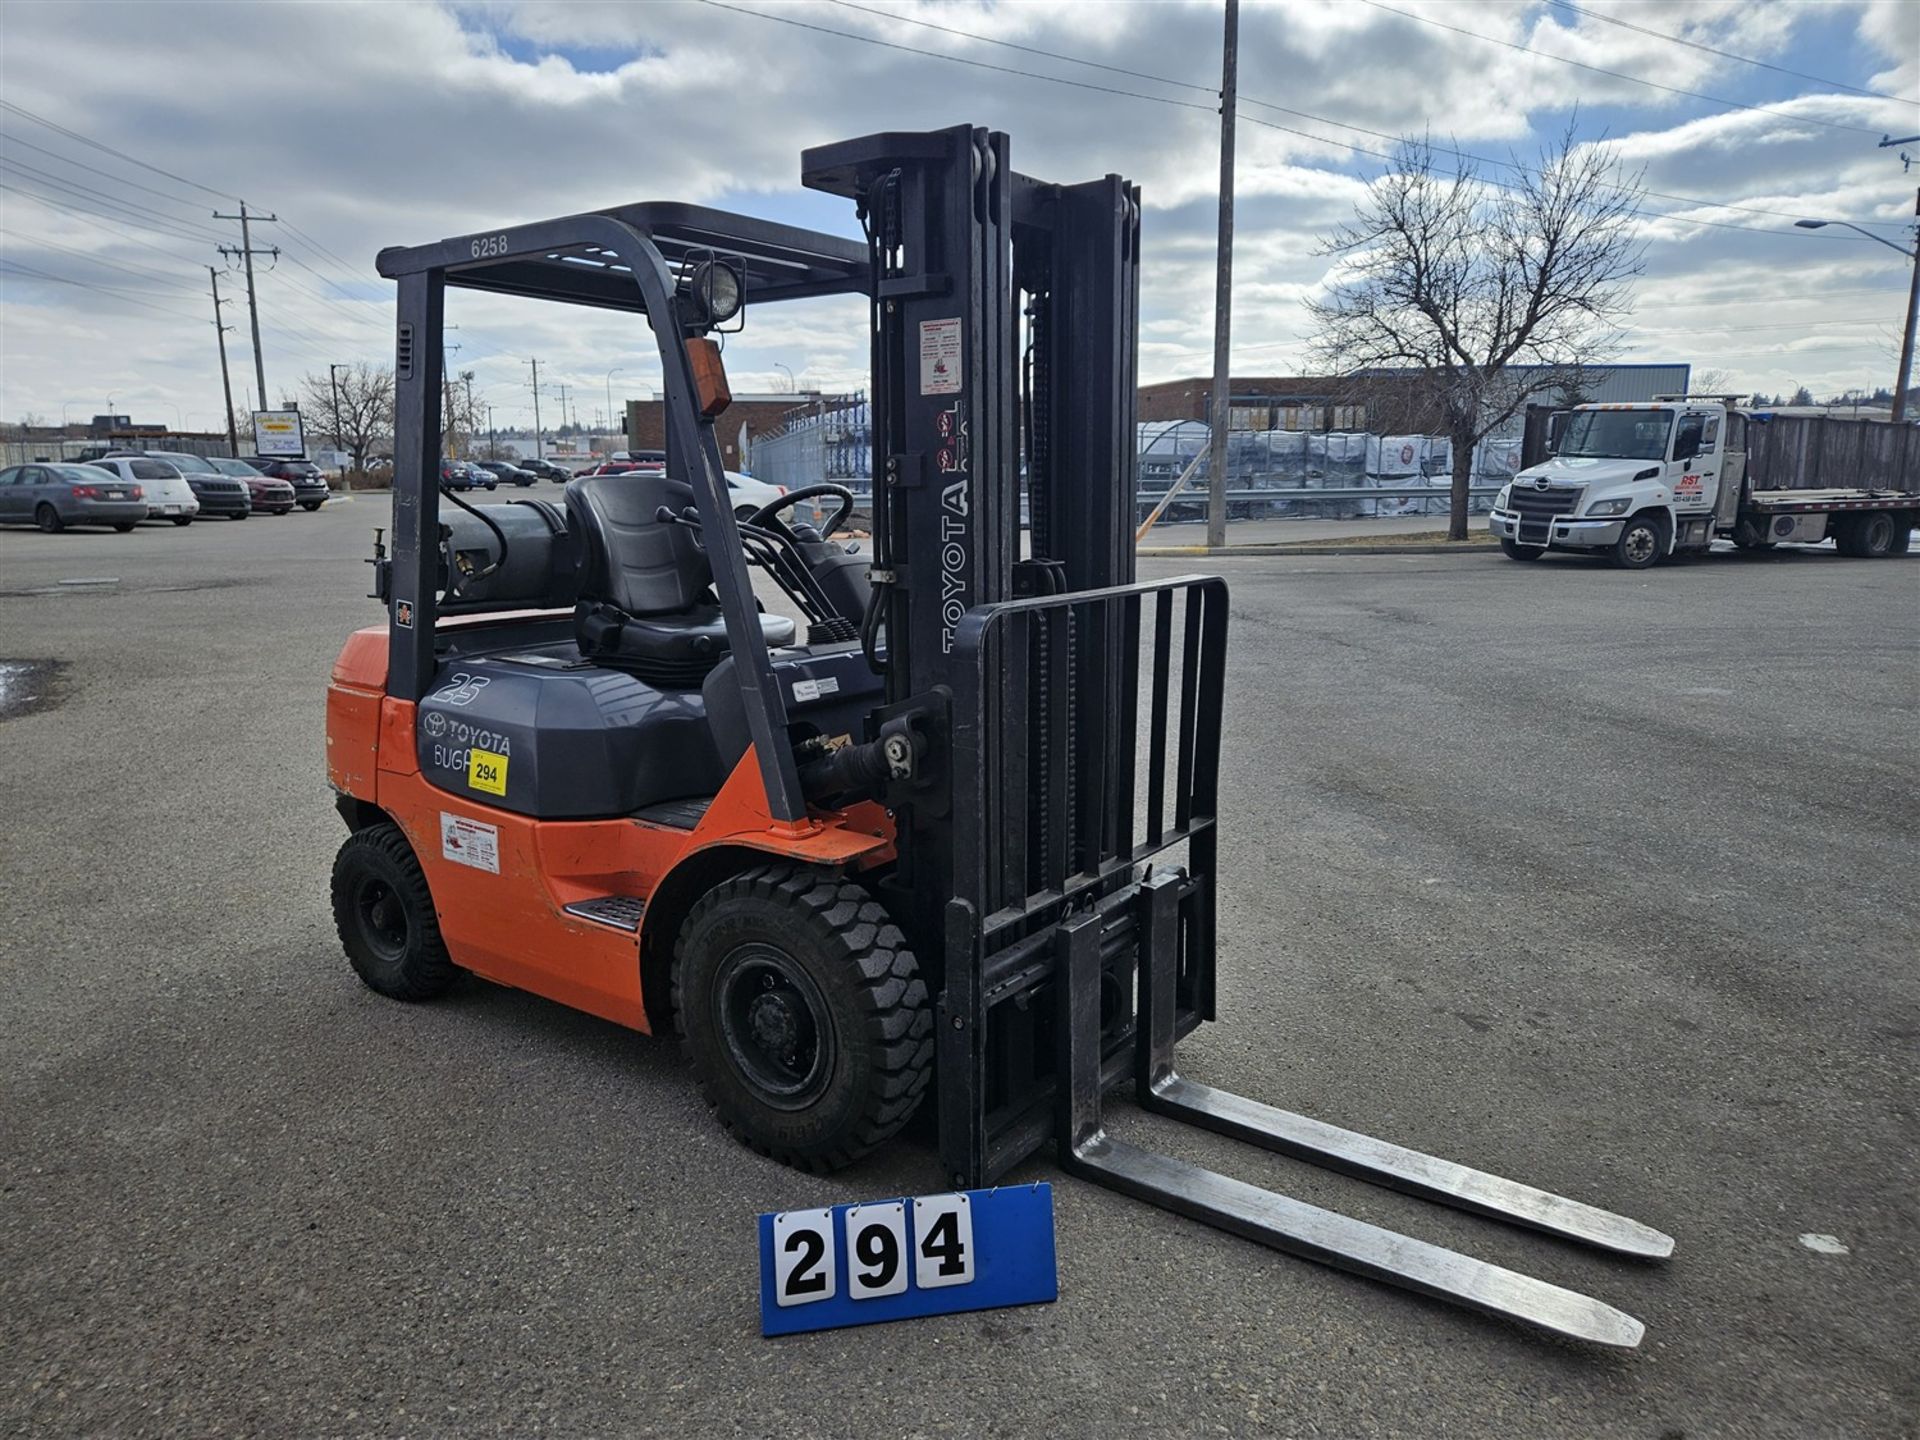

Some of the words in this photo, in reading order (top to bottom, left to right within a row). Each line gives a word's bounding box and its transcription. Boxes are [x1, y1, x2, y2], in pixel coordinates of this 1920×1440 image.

[471, 234, 508, 258] 6258
[1681, 475, 1701, 485] RST
[941, 479, 968, 654] TOYOTA
[431, 672, 491, 706] 25
[448, 719, 511, 756] TOYOTA
[434, 744, 472, 773] BUGA
[475, 762, 498, 783] 294
